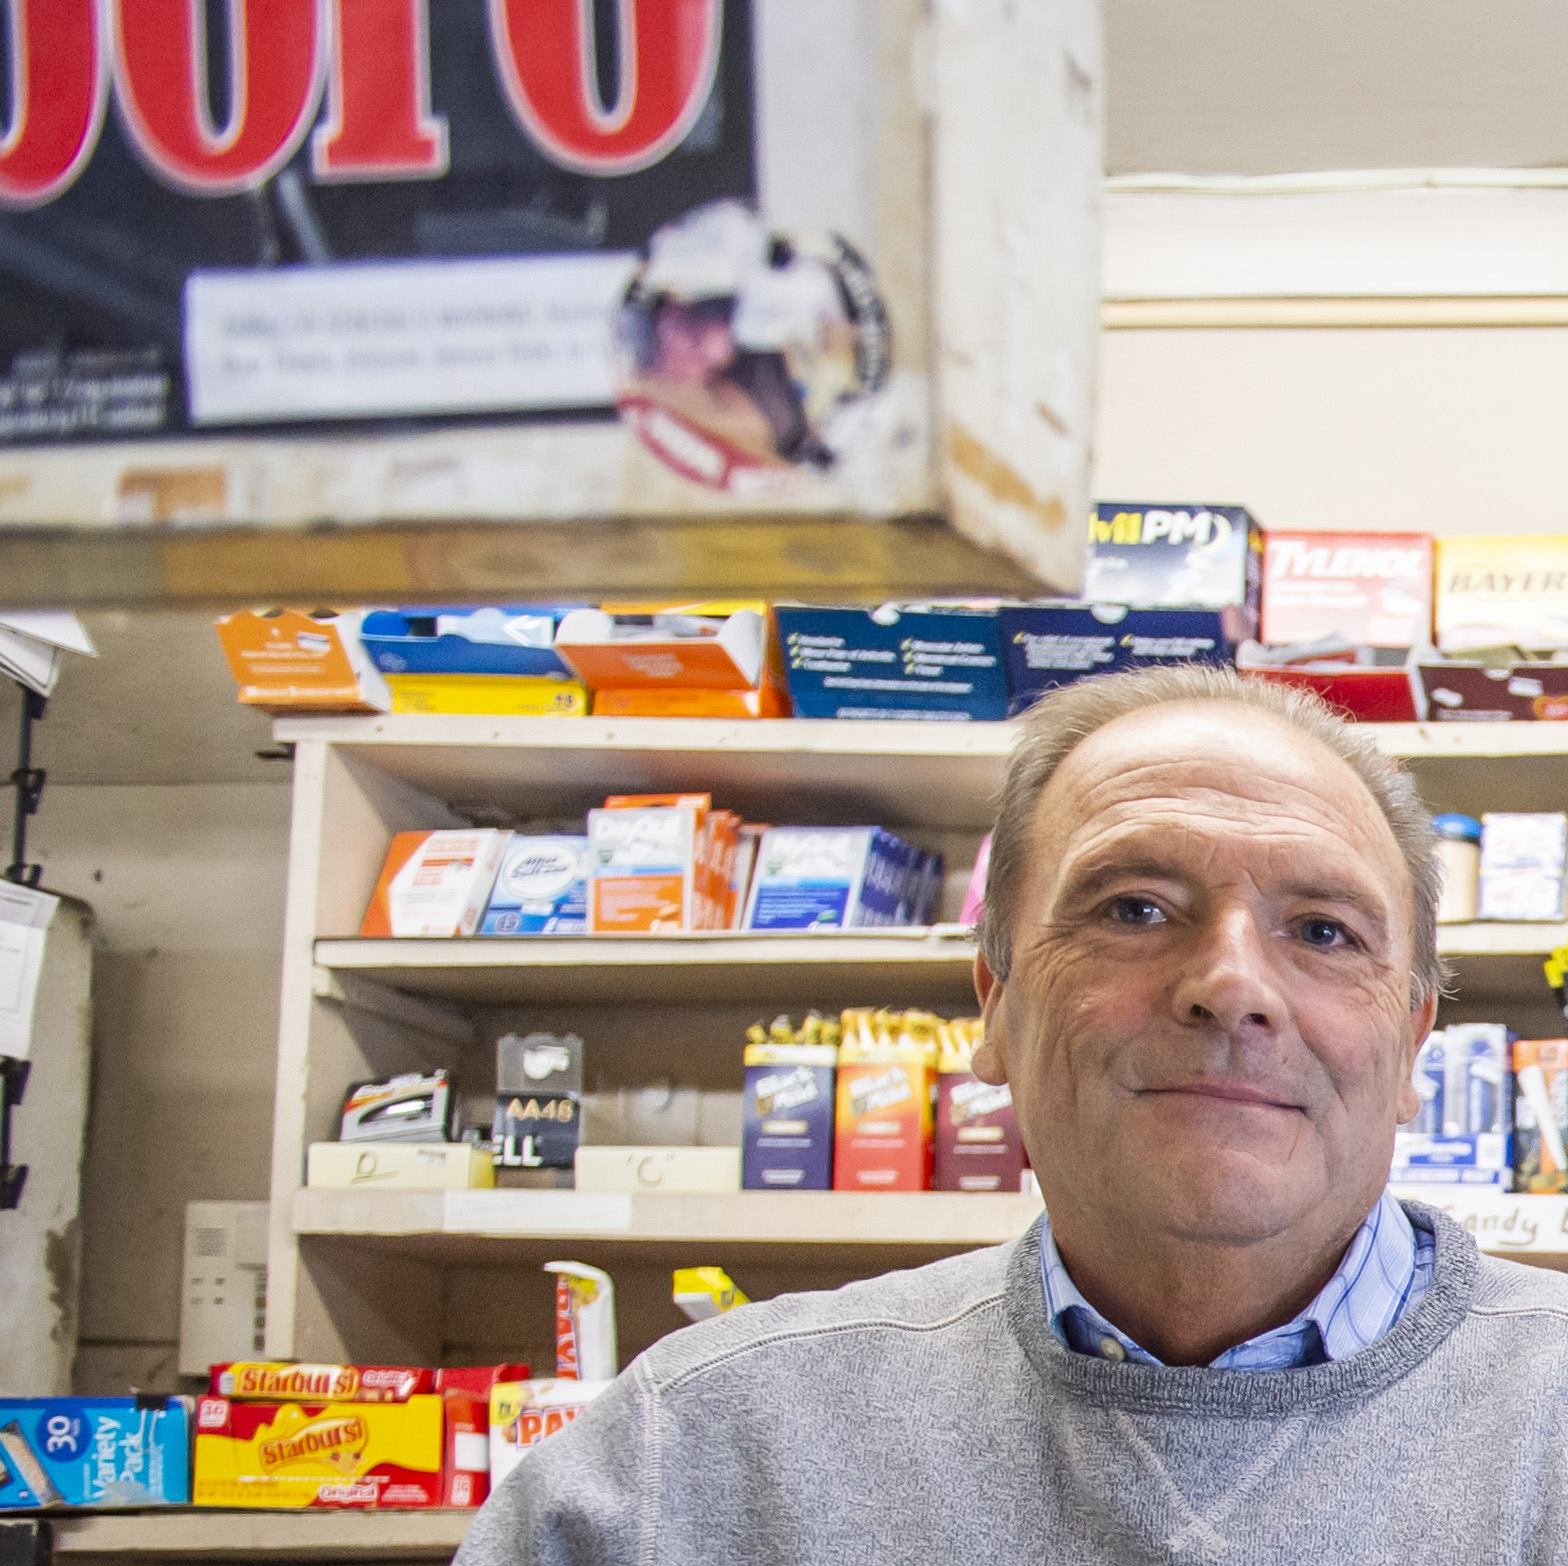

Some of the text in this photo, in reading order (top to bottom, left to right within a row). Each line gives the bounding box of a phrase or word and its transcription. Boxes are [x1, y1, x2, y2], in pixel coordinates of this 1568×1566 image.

[1142, 510, 1214, 546] PM
[1450, 569, 1568, 593] BAYER
[241, 1367, 356, 1393] Starburst
[47, 1415, 77, 1453] 30
[262, 1416, 364, 1465] Starburst
[92, 1416, 122, 1499] Variety
[319, 1484, 378, 1501] Original
